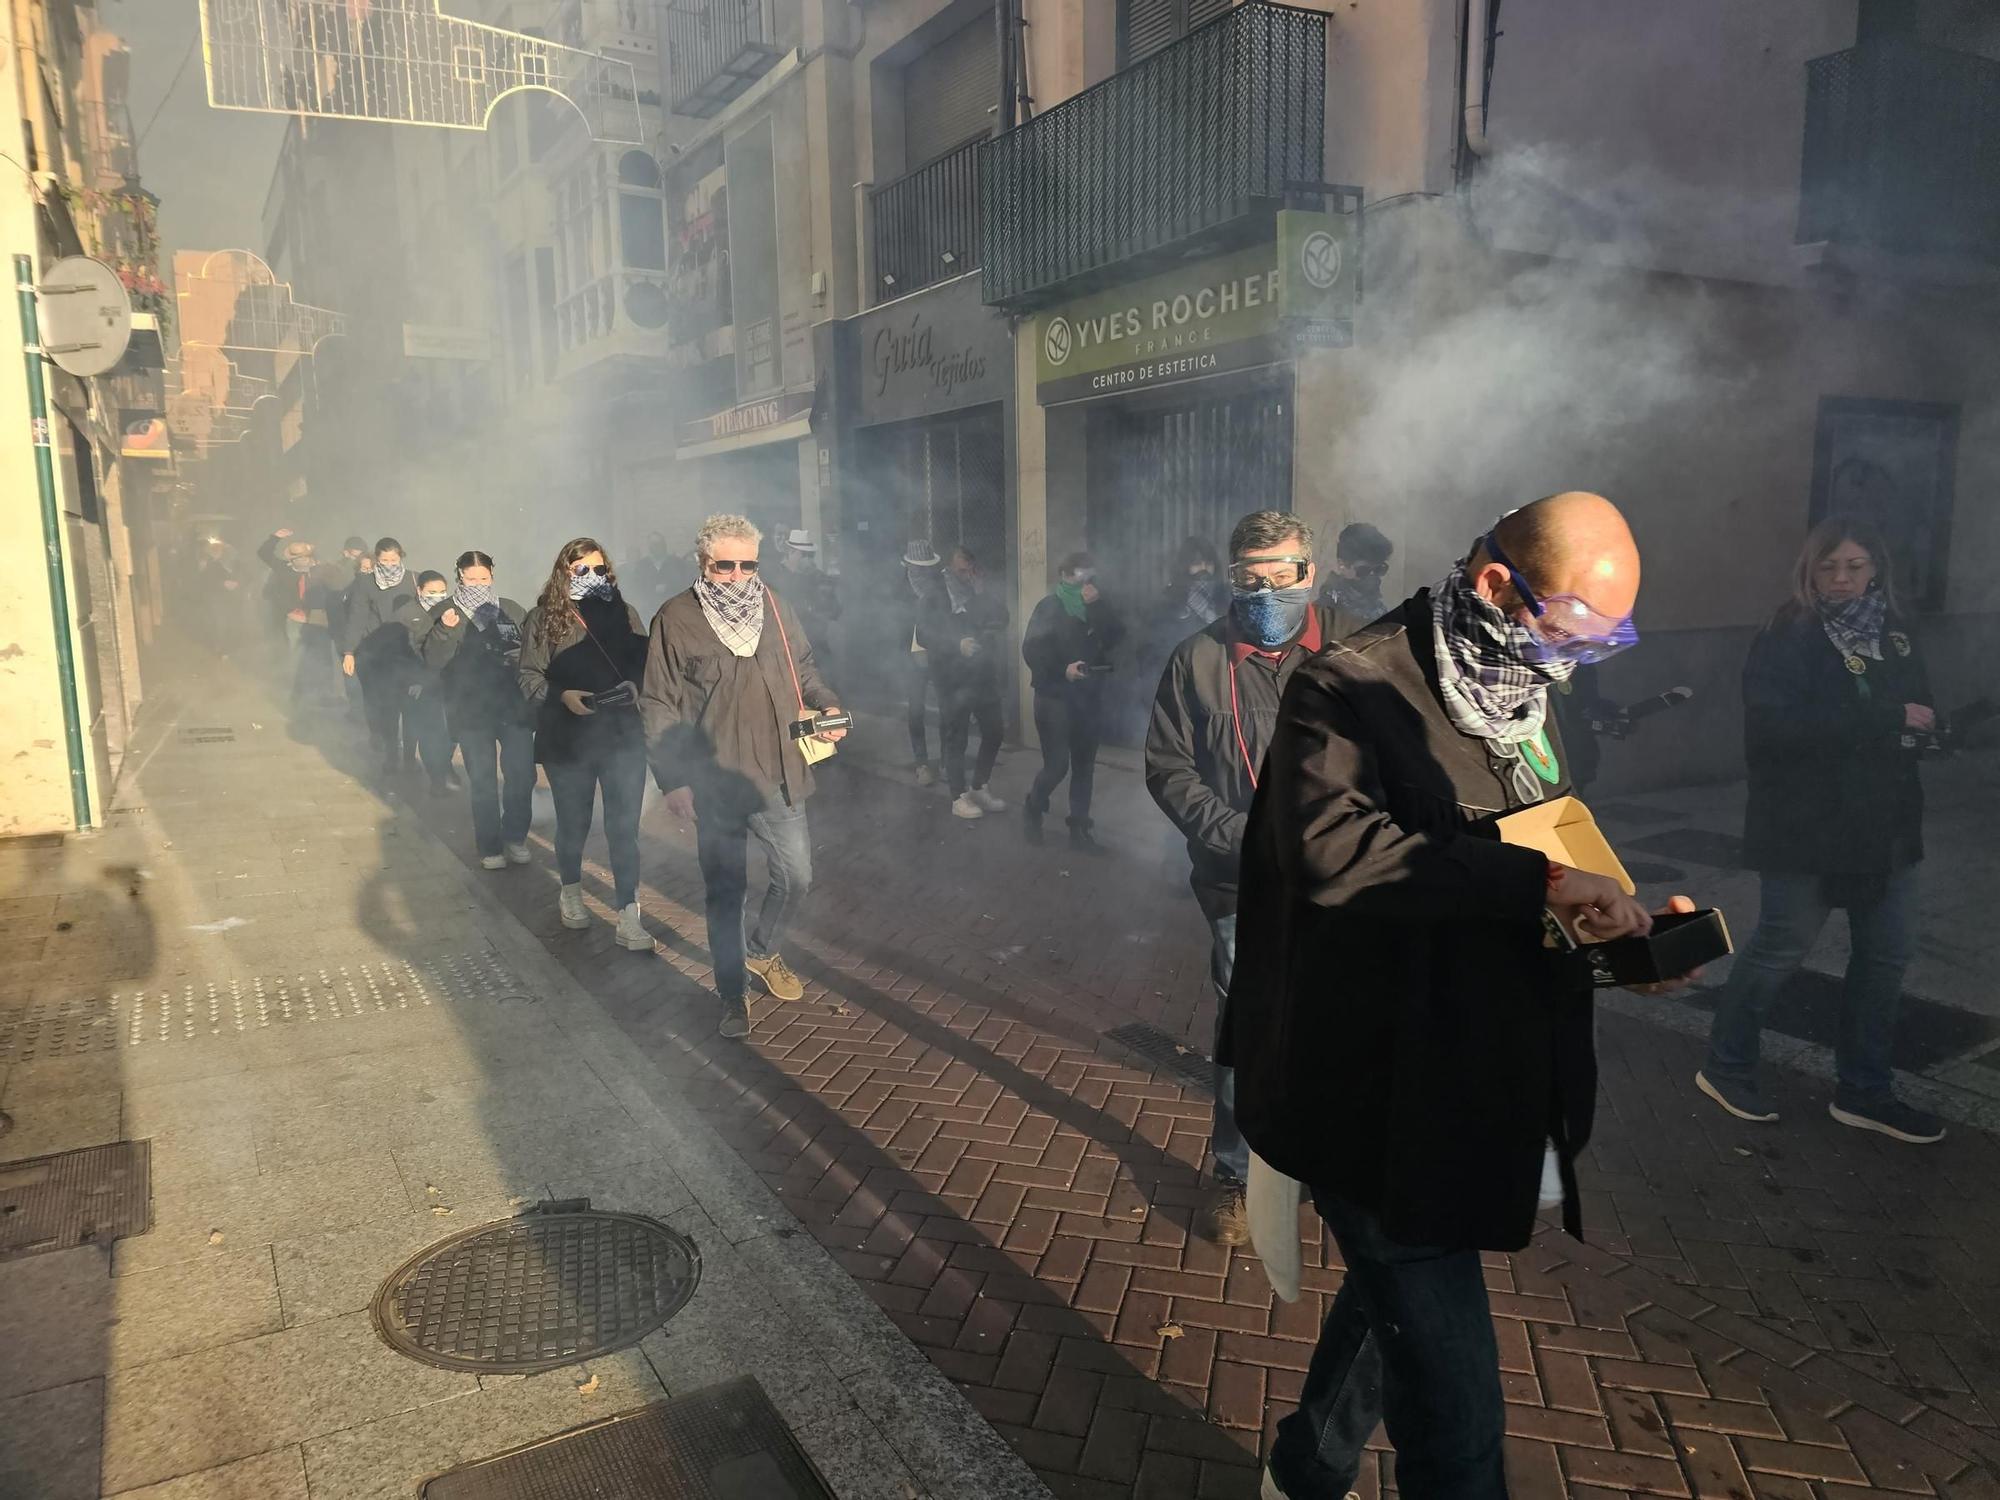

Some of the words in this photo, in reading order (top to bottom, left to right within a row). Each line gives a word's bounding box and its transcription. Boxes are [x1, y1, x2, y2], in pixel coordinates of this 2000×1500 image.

[1075, 307, 1141, 348] YVES
[1152, 269, 1279, 330] ROCHER
[873, 313, 933, 397] Guía
[1135, 327, 1211, 356] FRANCE
[930, 346, 987, 396] Tejidos
[1092, 369, 1135, 389] CENTRO
[1139, 366, 1153, 380] DE
[1158, 353, 1217, 377] ESTETICA
[712, 401, 778, 435] PIERCING
